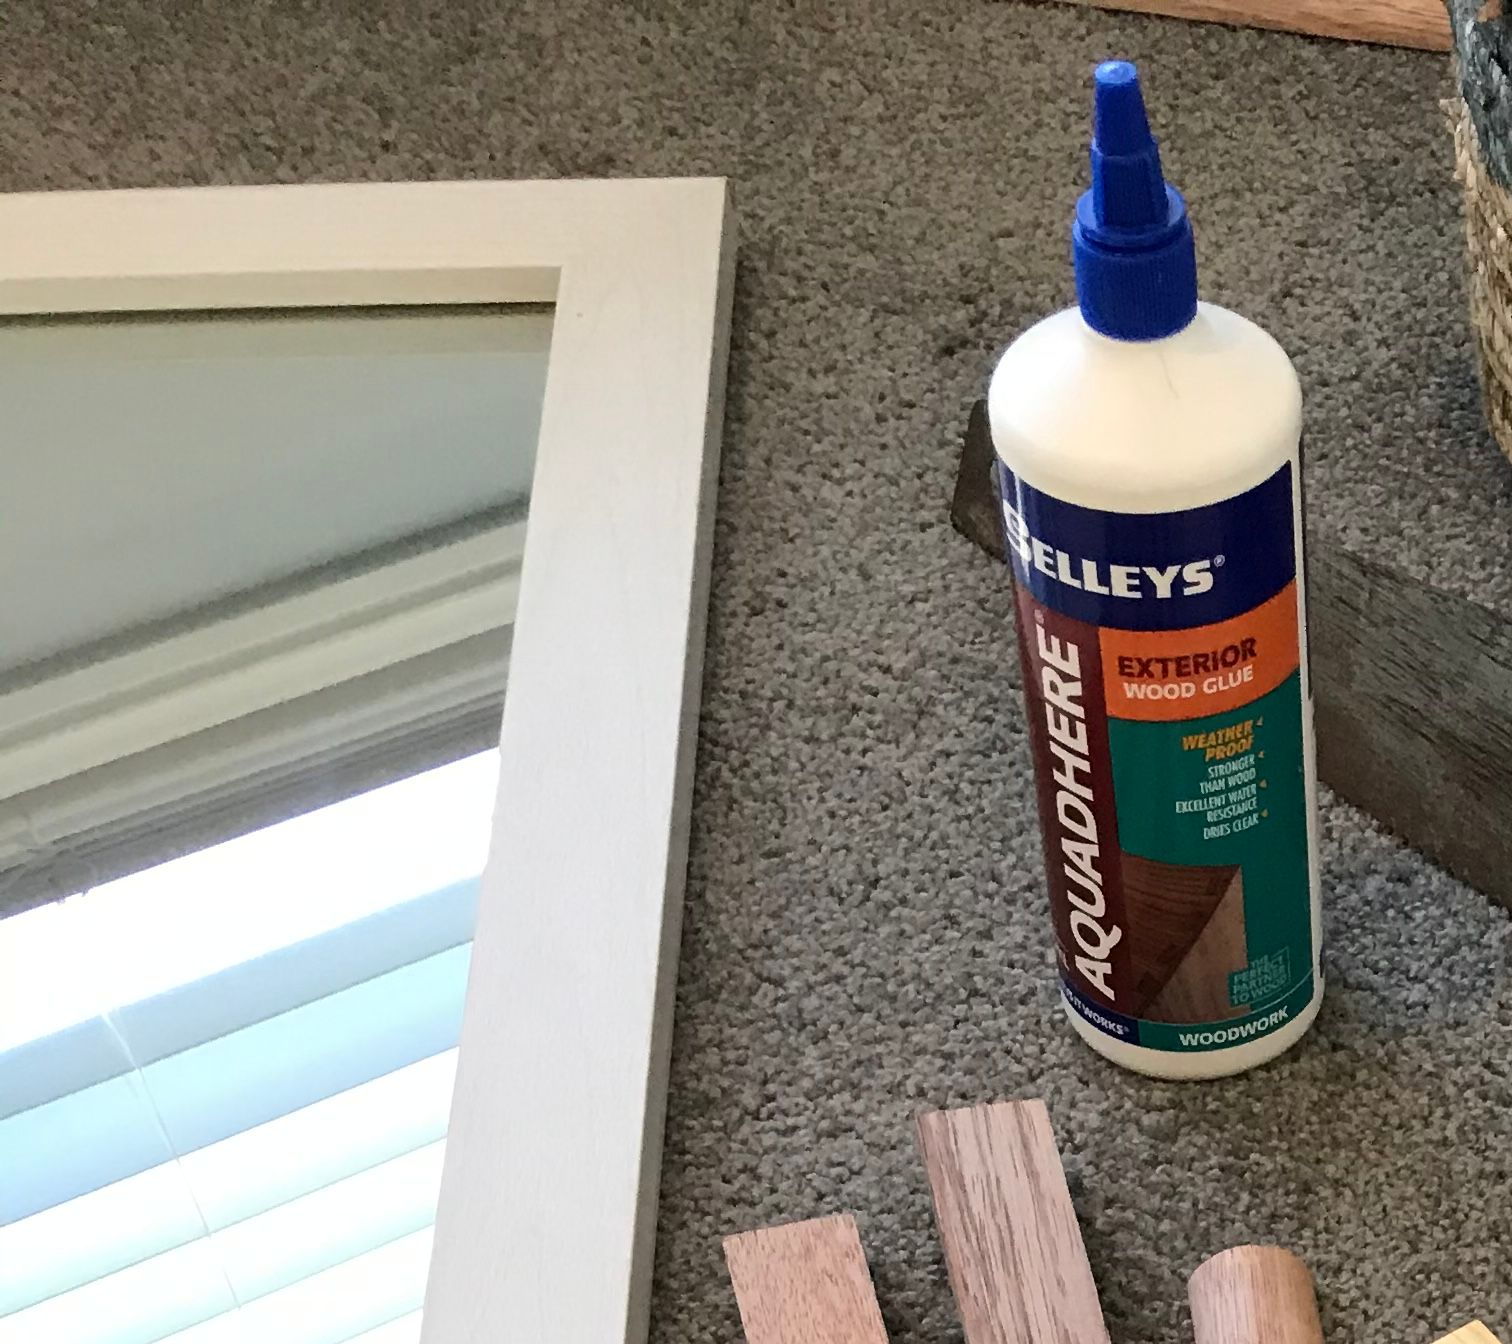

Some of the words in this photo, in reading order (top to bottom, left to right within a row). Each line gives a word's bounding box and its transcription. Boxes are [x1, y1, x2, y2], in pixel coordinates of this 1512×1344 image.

[1117, 637, 1257, 679] EXTERIOR
[1123, 682, 1197, 700] WOOD
[1202, 665, 1254, 694] GLUE
[1182, 719, 1254, 751] WEATHER
[1205, 735, 1254, 762] PROOF
[1200, 778, 1226, 794] THAN
[1228, 767, 1257, 788] WOOD
[1208, 754, 1256, 779] STRONGER
[1035, 623, 1122, 1001] AQUADHERE
[1175, 794, 1226, 814] EXCELLENT
[1206, 796, 1258, 822] RESISTANCE
[1178, 1005, 1289, 1046] WOODWORK
